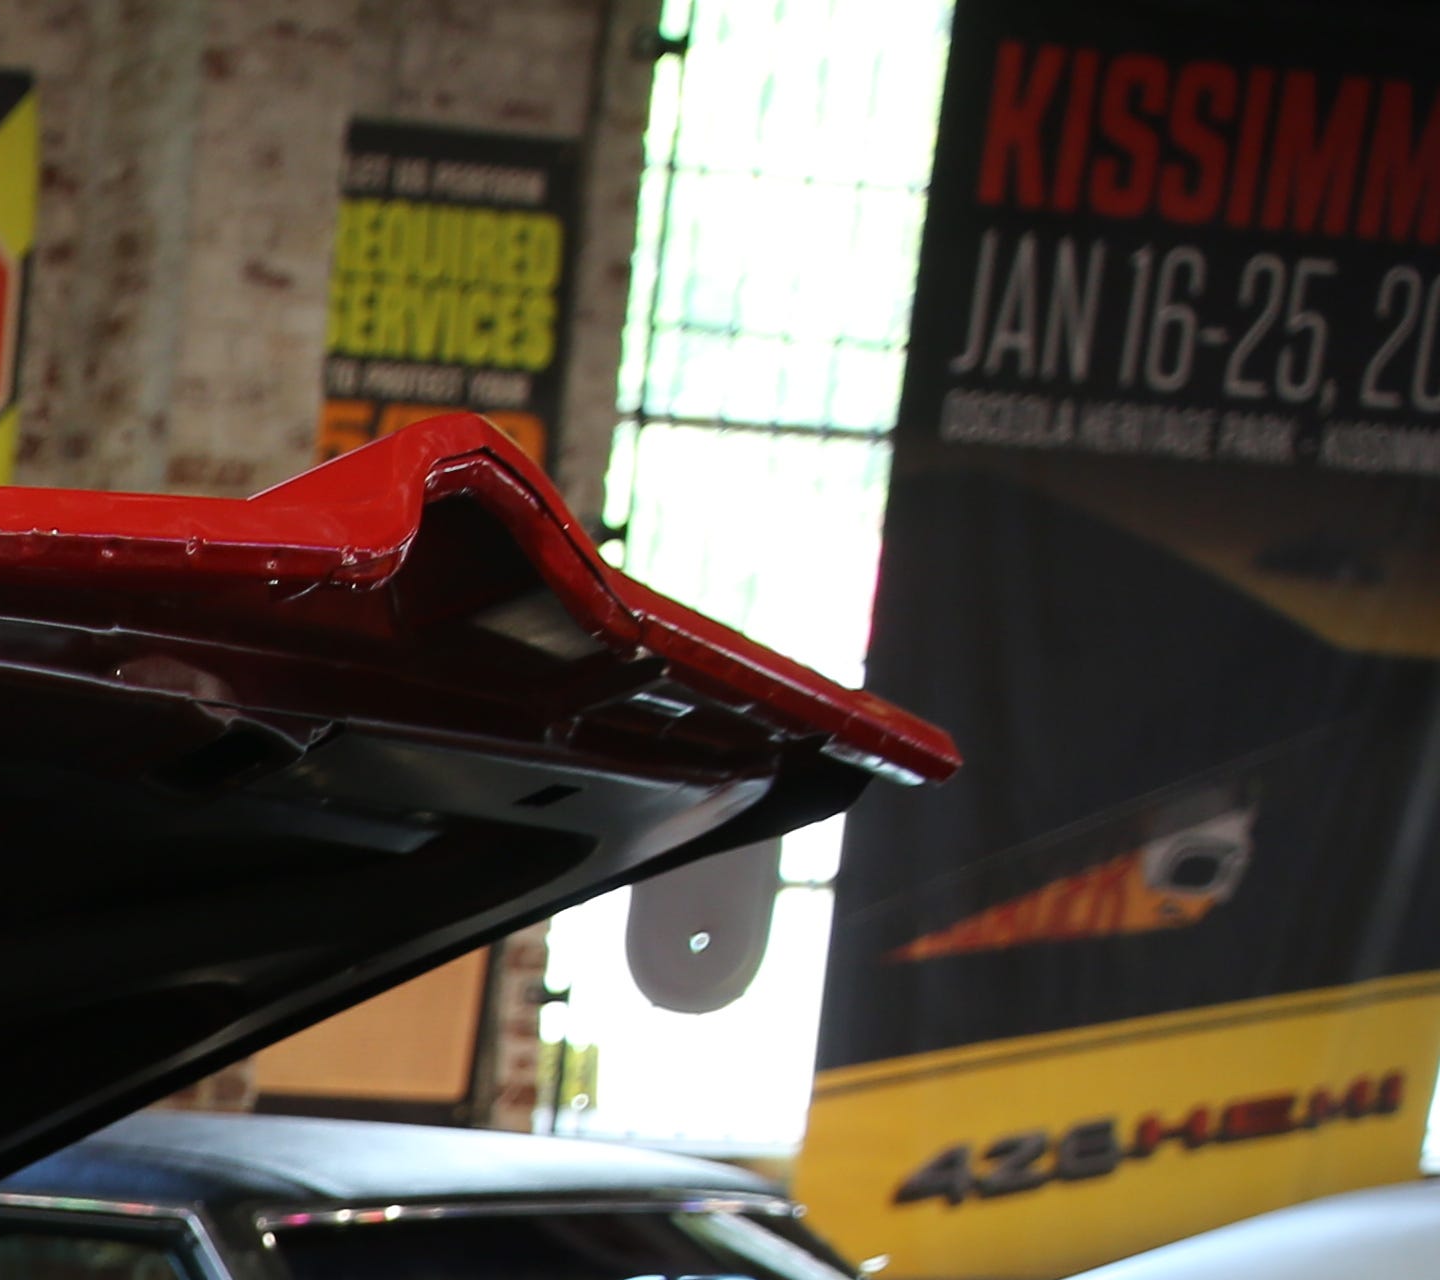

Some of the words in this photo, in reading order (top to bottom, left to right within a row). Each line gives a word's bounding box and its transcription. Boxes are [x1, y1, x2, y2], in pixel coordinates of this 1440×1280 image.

[337, 198, 564, 287] REQUIRED
[327, 273, 557, 372] SERVICES
[950, 227, 1106, 384] JAN
[1120, 245, 1338, 413] 16-25,
